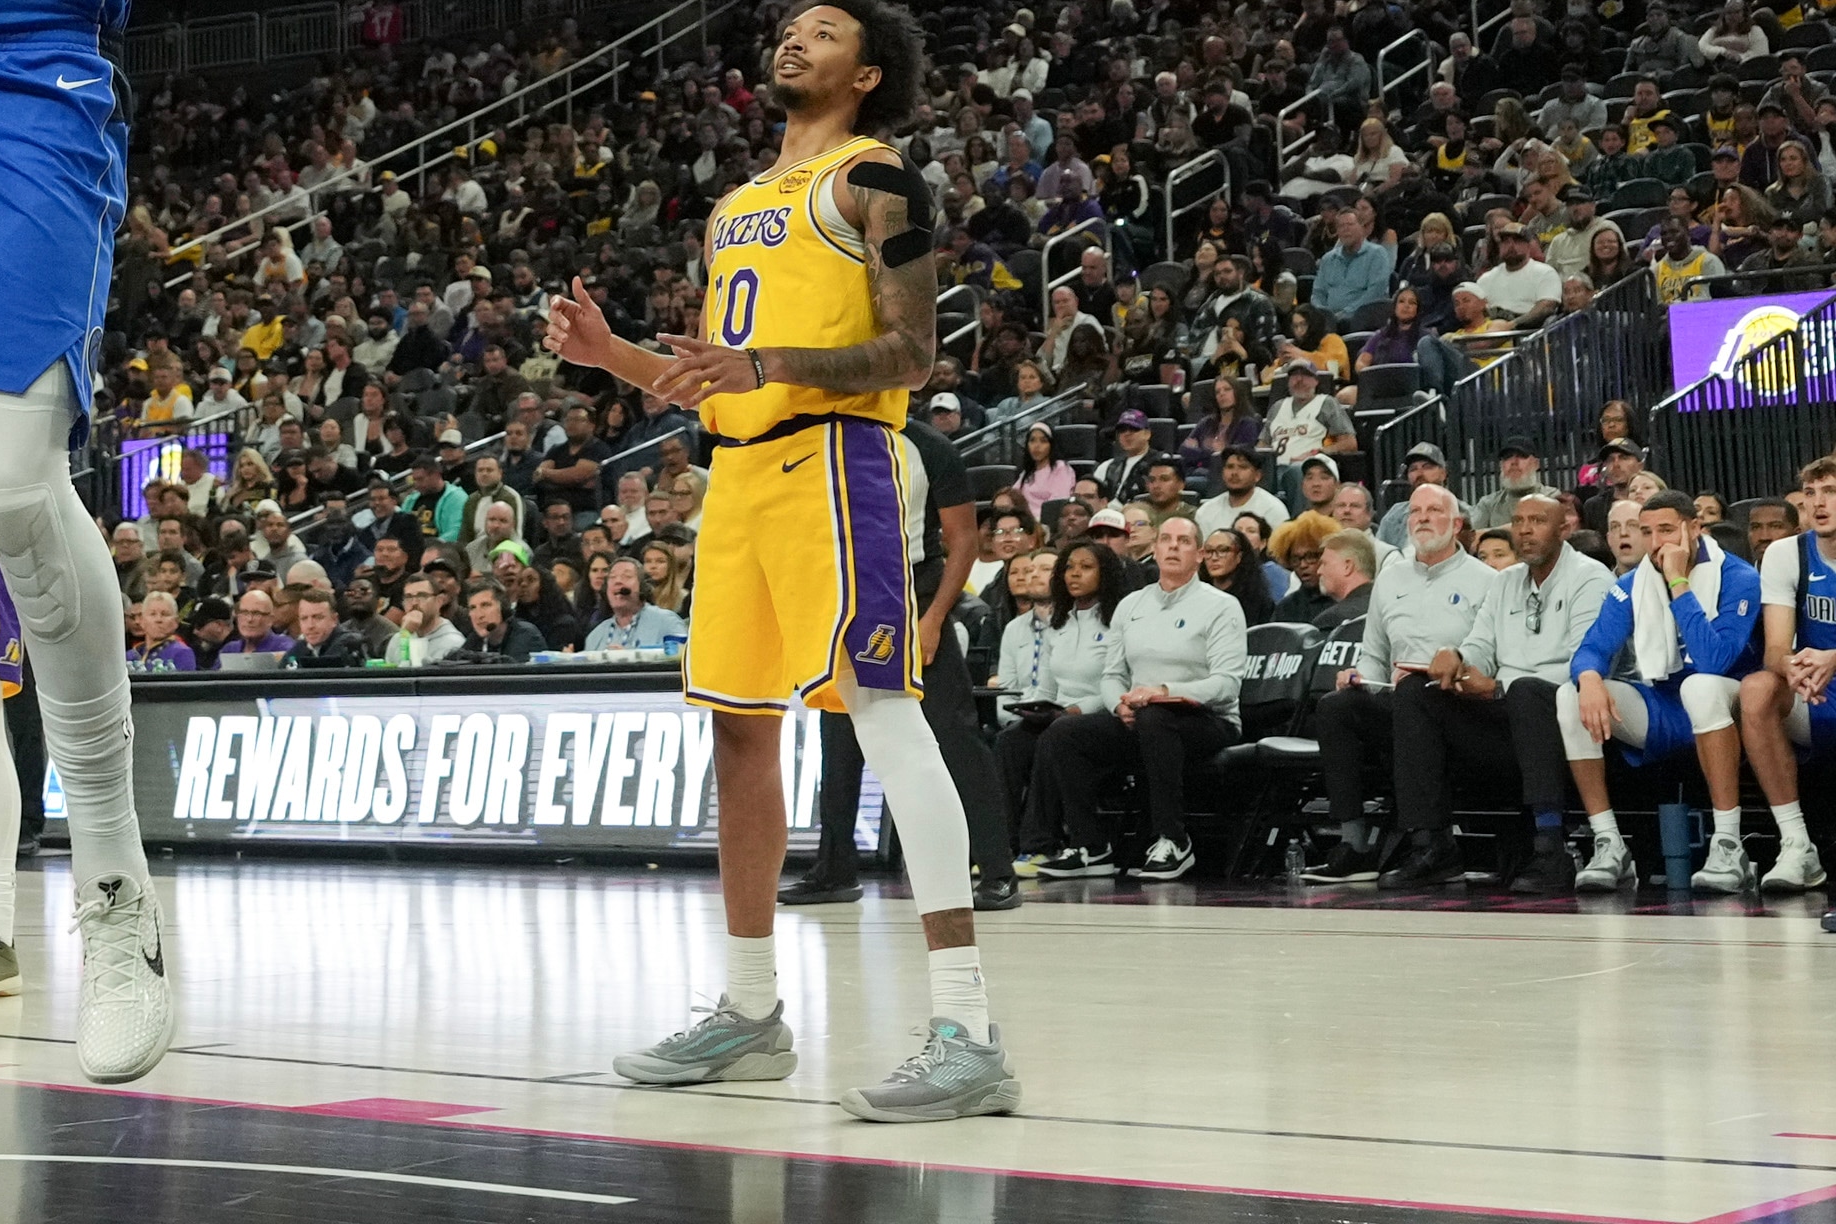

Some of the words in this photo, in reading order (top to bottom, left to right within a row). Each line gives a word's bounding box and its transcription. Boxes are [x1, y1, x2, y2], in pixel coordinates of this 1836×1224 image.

[713, 206, 794, 250] AKERS
[1244, 655, 1266, 679] HE
[1317, 641, 1353, 666] GET
[173, 713, 417, 824] REWARDS
[417, 713, 532, 826] FOR
[534, 711, 714, 827] EVERY
